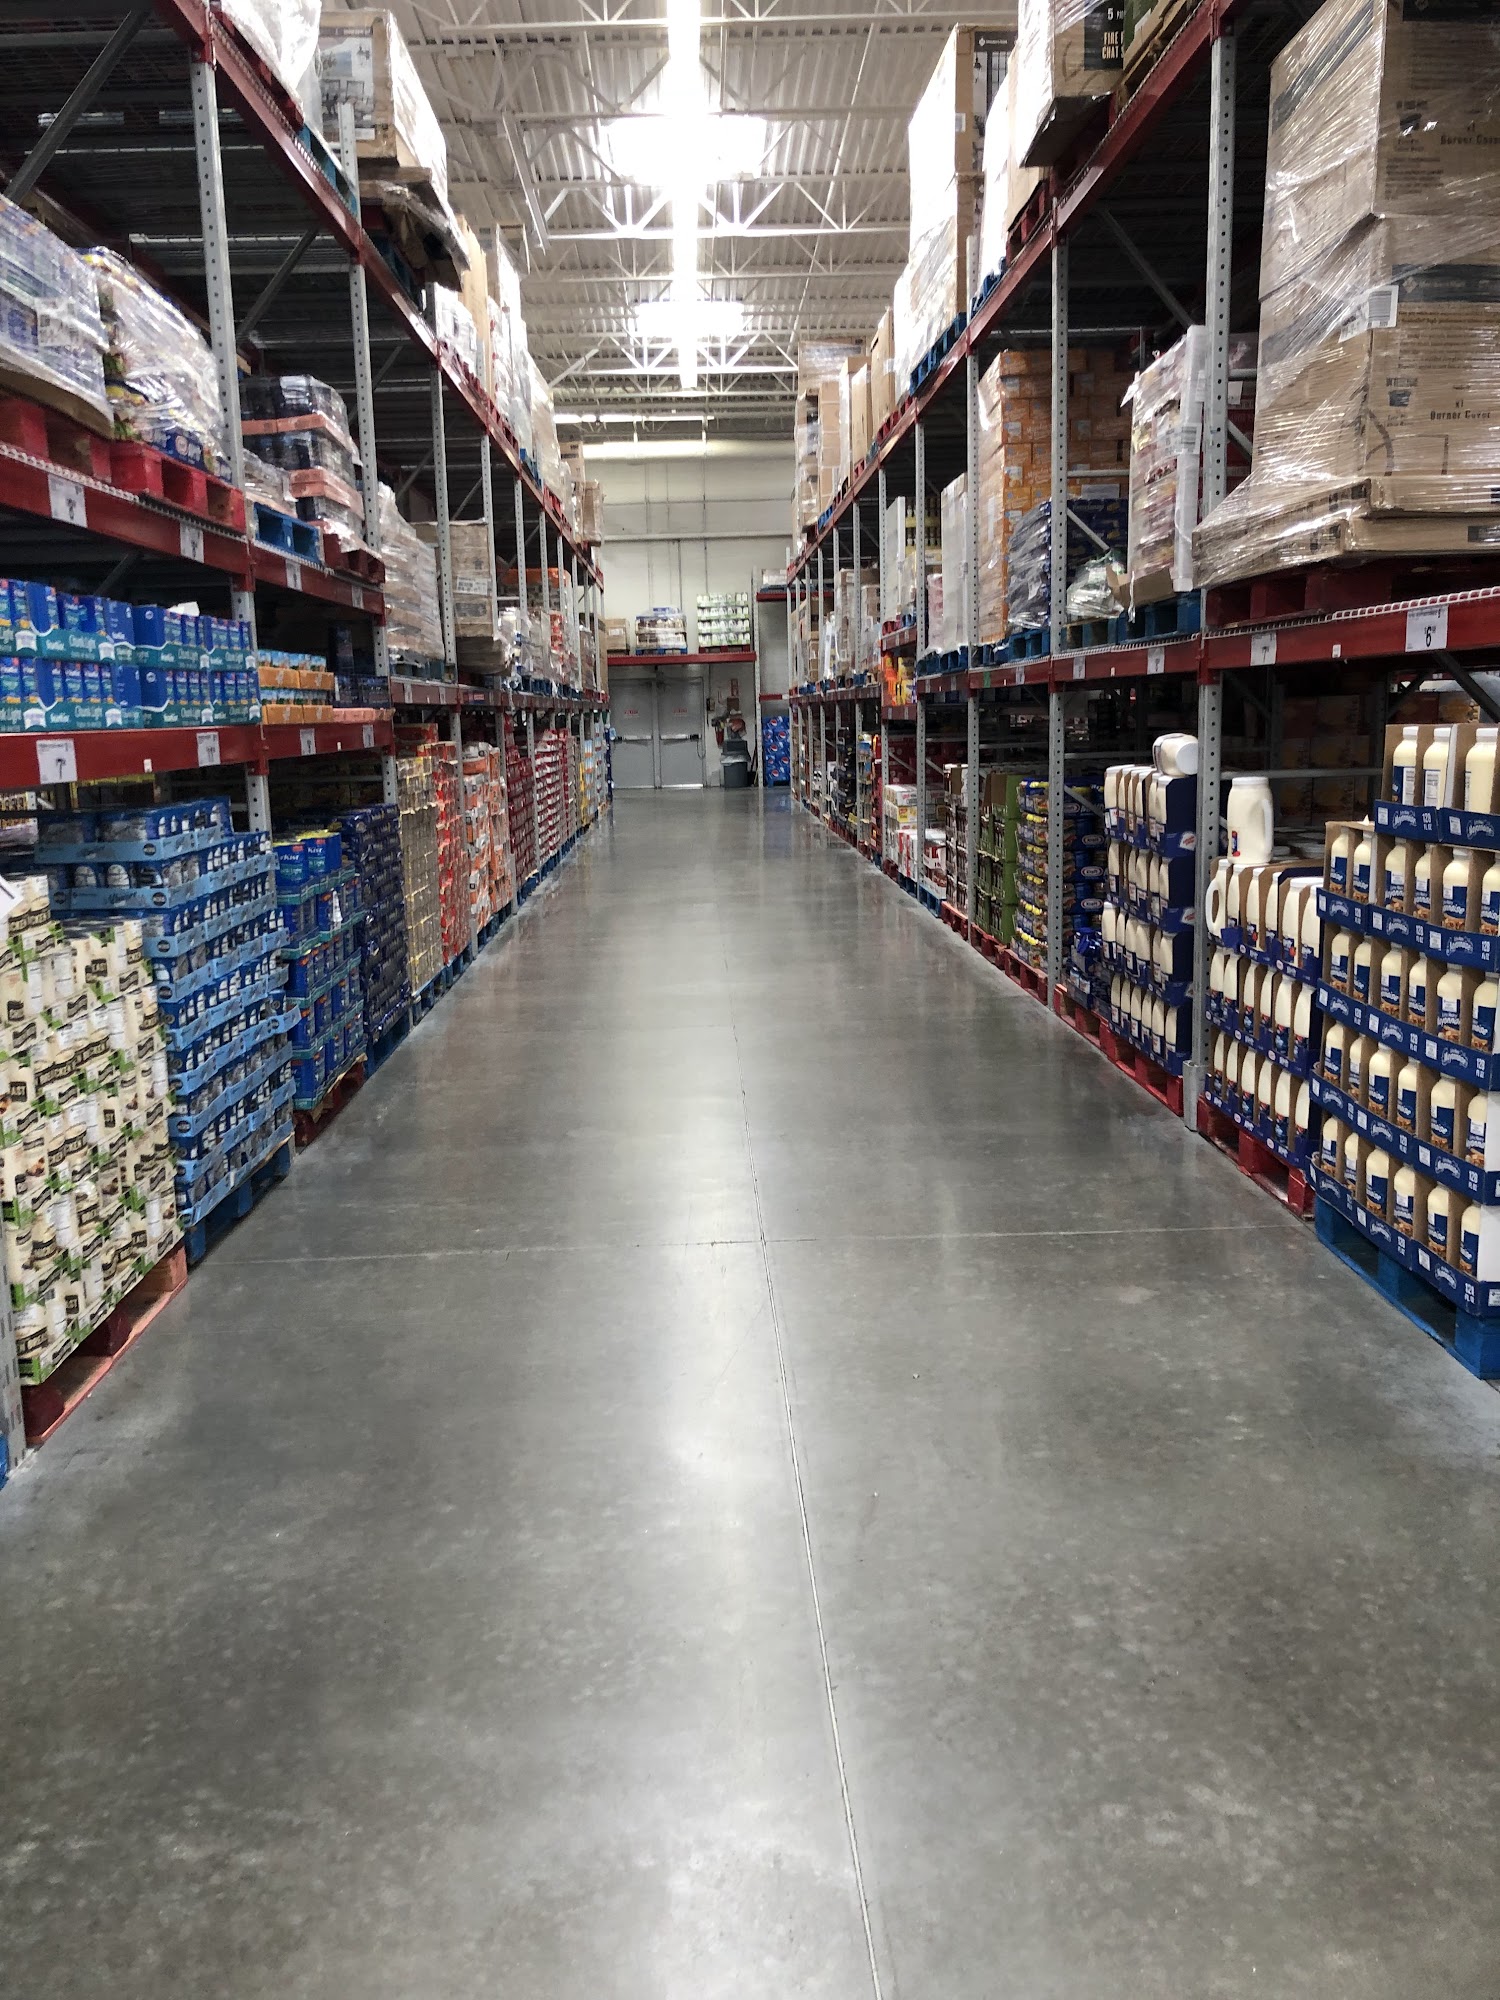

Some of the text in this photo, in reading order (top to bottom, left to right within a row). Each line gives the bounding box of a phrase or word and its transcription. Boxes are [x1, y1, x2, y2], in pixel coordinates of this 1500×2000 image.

[1104, 32, 1118, 45] FIRE
[1102, 46, 1119, 60] CHAT
[1430, 410, 1491, 420] Burner Cover
